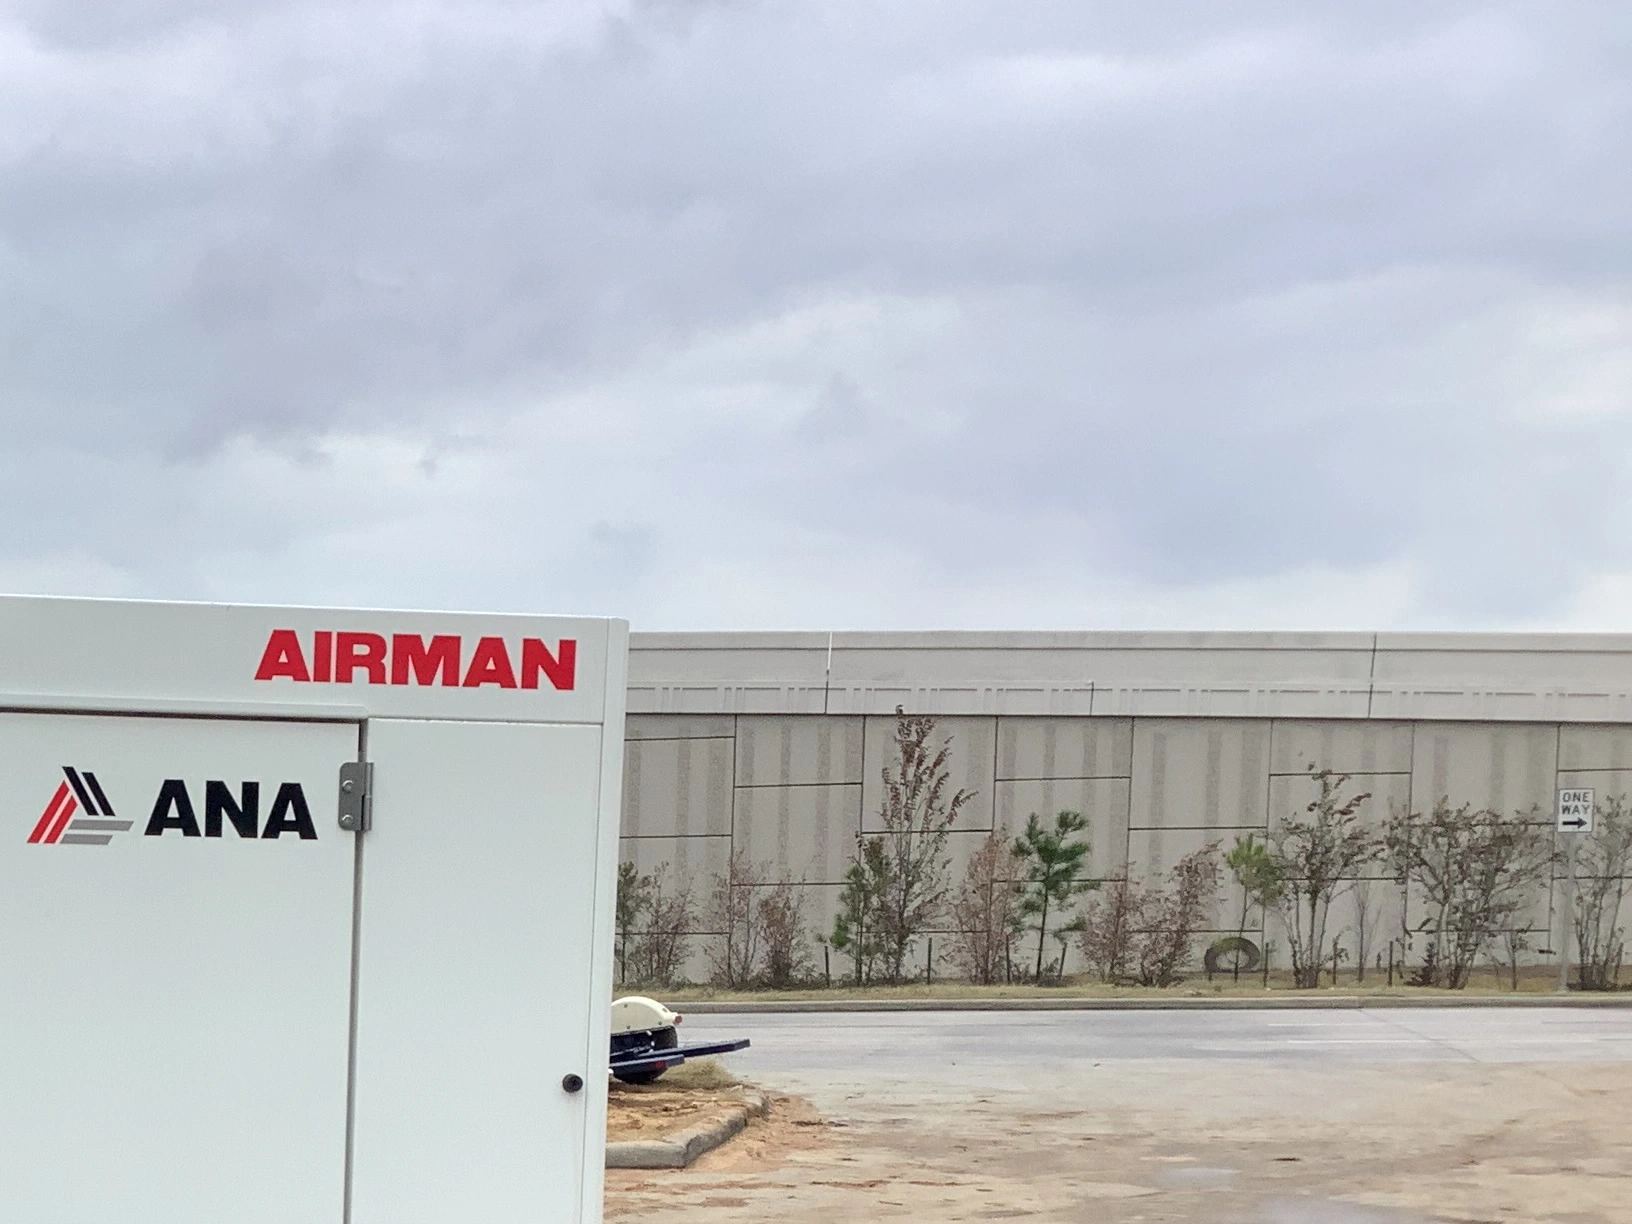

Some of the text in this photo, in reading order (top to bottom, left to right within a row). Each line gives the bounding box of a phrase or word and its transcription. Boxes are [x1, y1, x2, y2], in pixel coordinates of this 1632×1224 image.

[254, 629, 577, 691] AIRMAN
[144, 779, 318, 841] ANA
[1562, 792, 1590, 802] ONE
[1562, 805, 1590, 814] WAY
